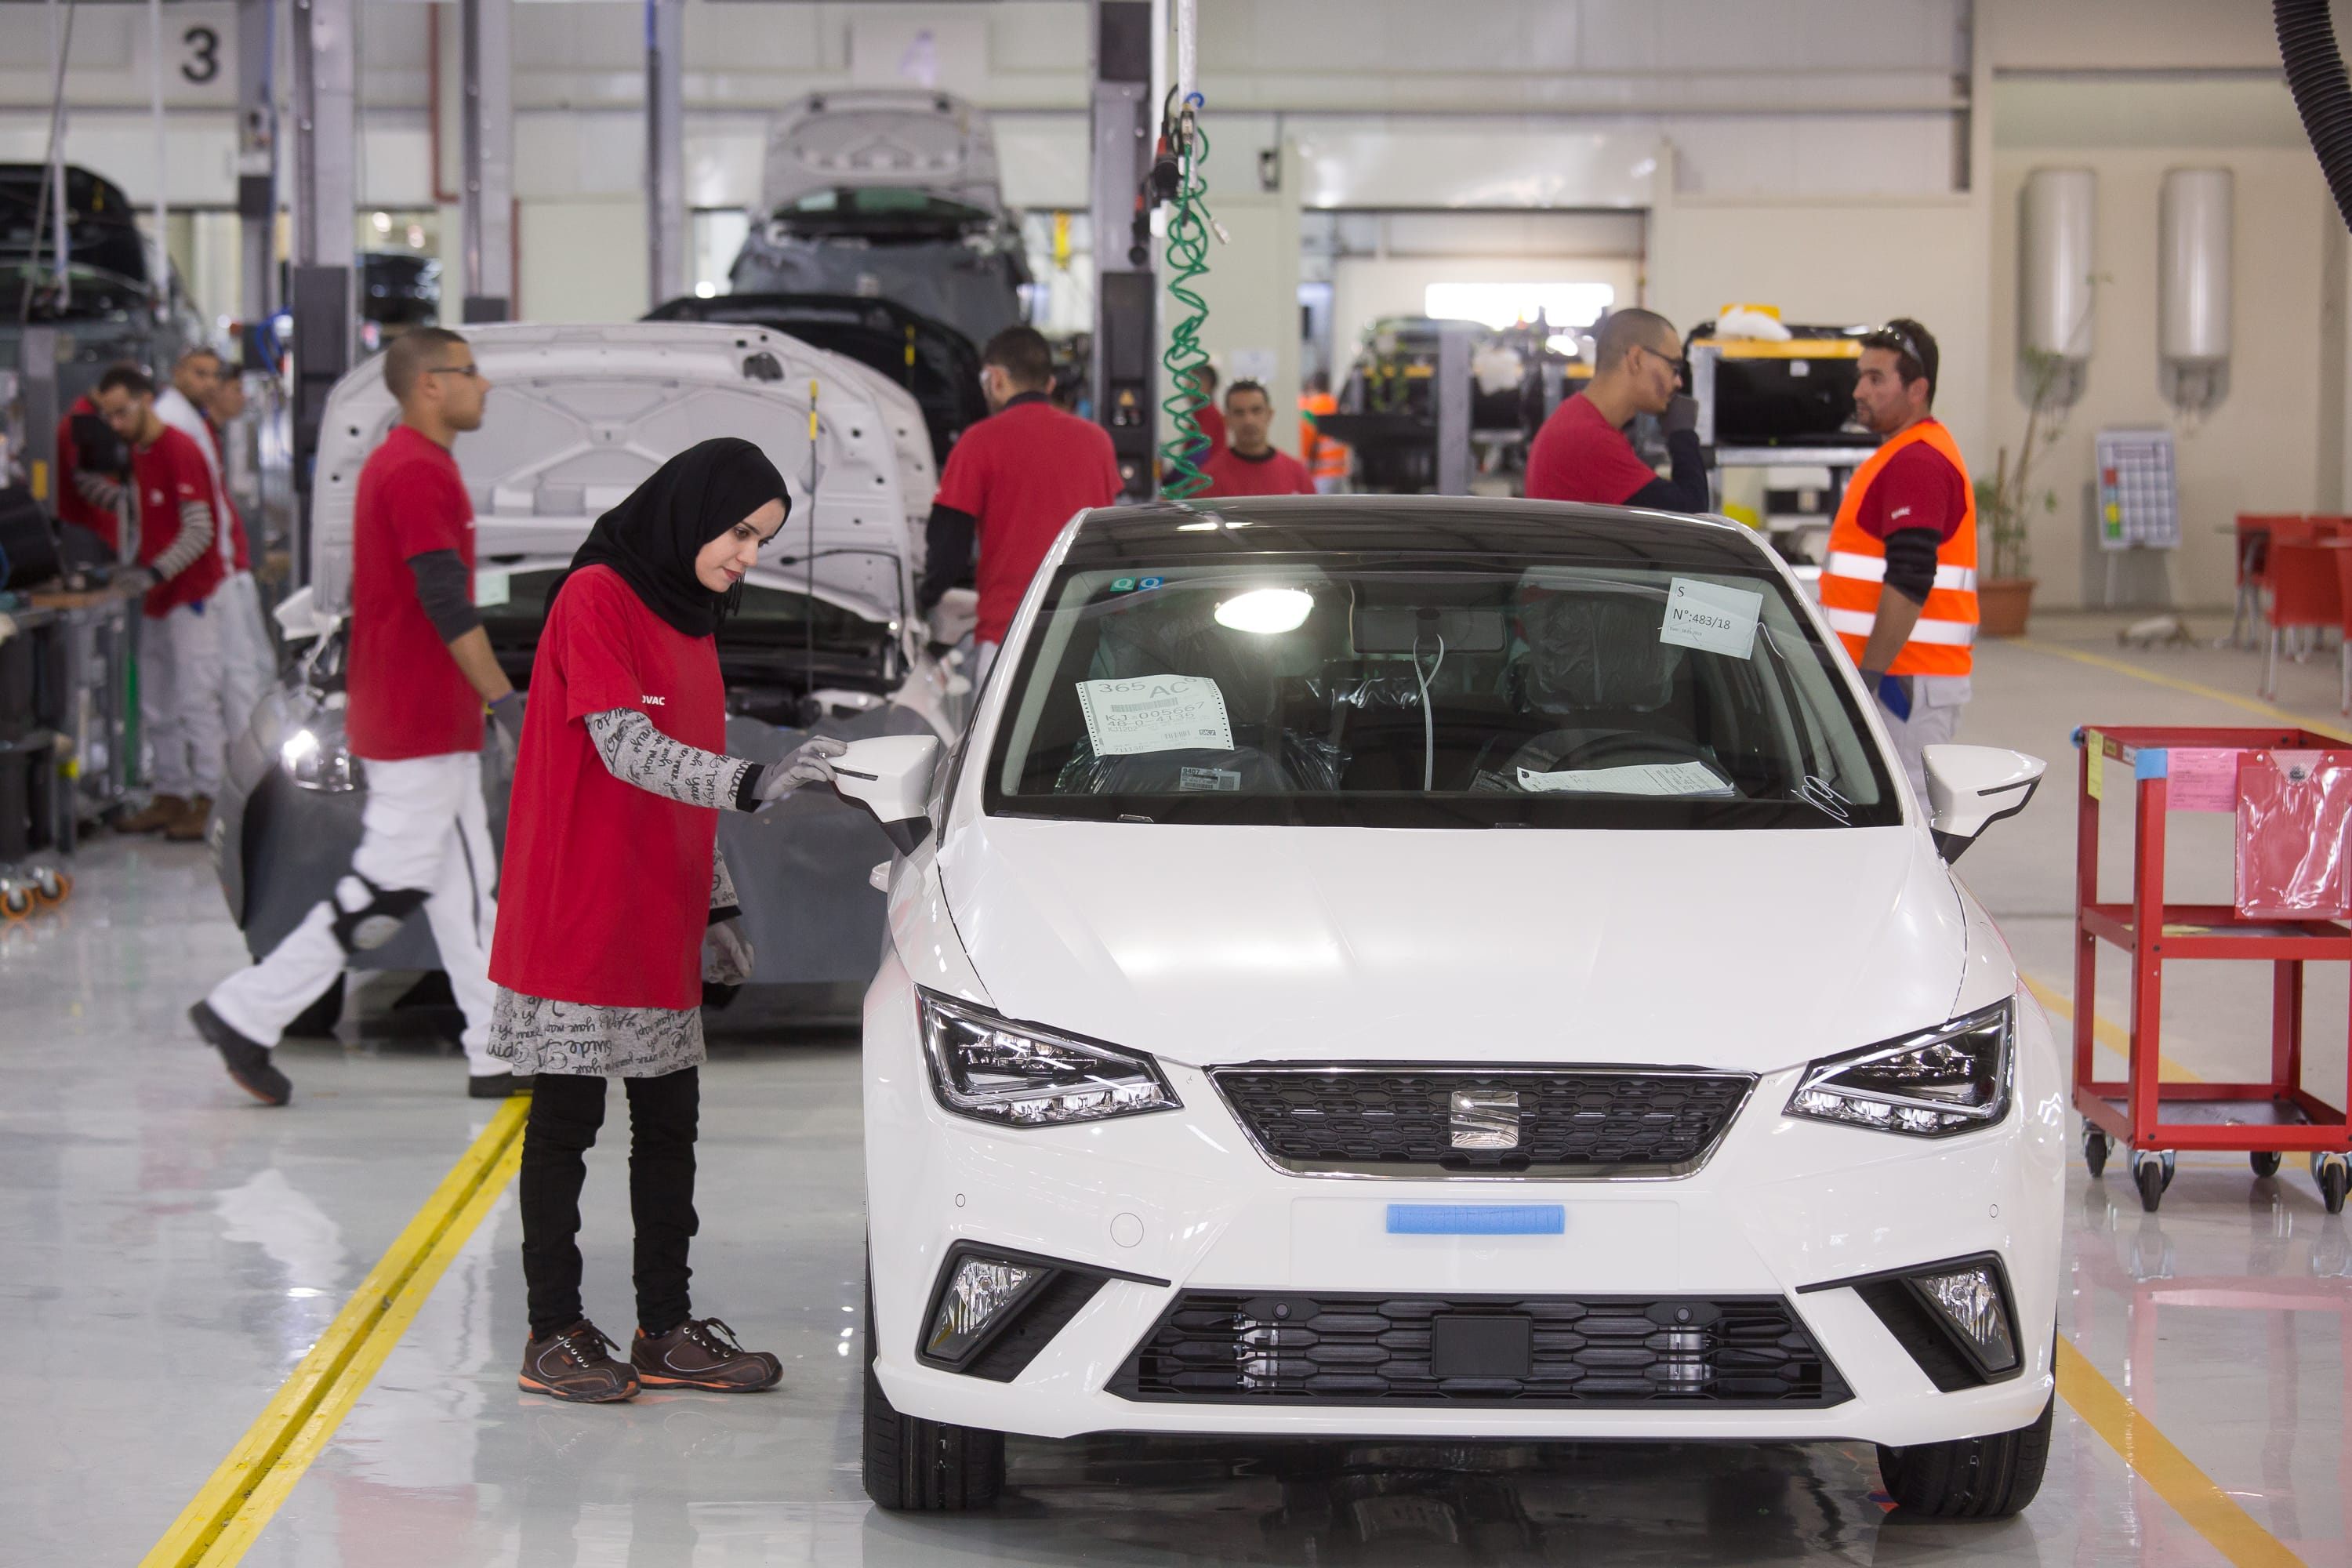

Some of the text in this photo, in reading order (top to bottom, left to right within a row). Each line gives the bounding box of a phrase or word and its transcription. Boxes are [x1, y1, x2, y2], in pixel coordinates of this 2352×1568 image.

[180, 27, 220, 83] 3
[1677, 586, 1685, 597] S
[1098, 681, 1146, 693] 365
